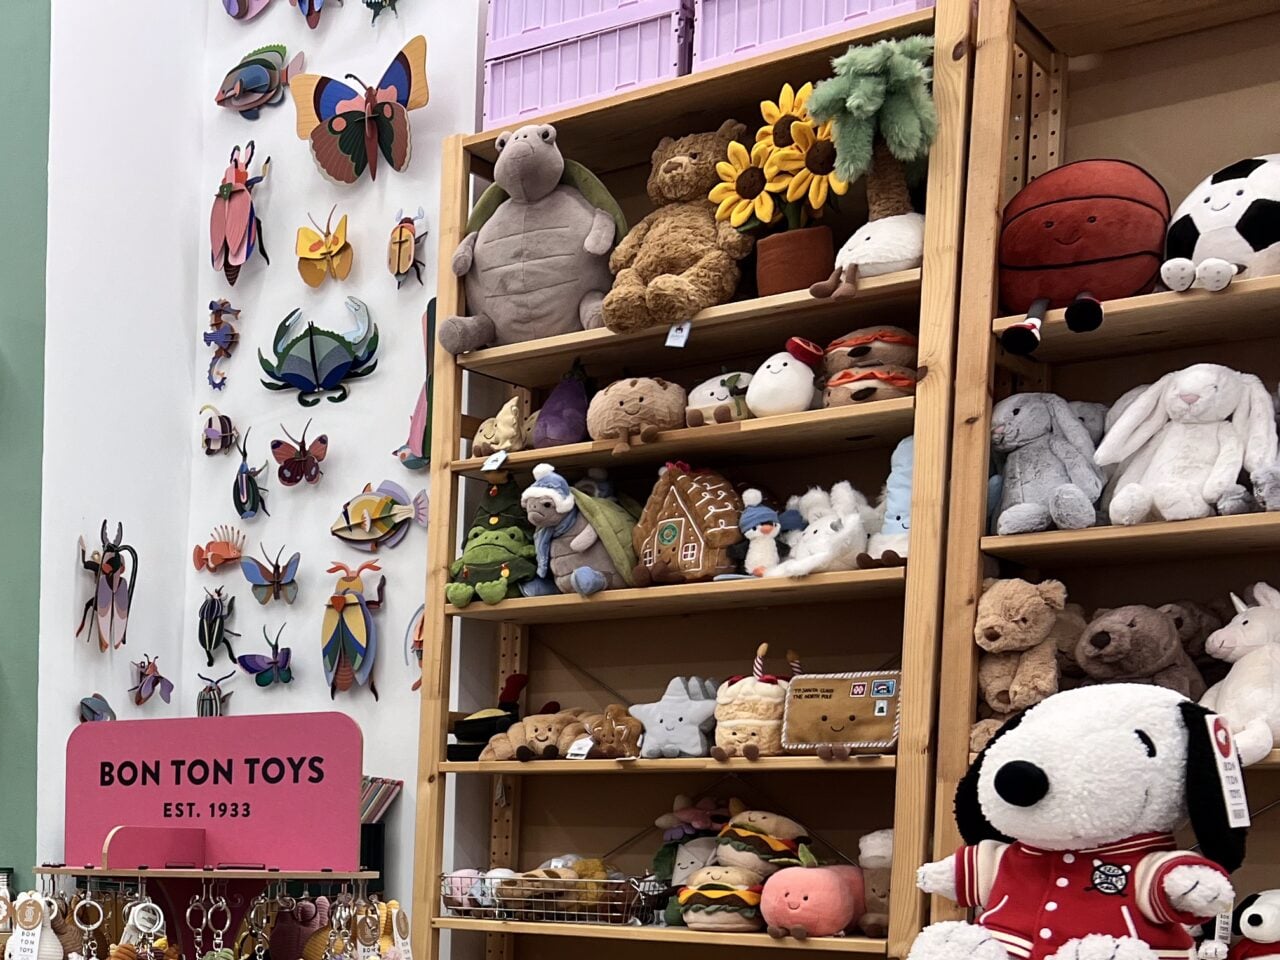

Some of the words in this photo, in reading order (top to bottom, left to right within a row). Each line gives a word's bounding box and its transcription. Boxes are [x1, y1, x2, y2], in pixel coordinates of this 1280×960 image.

[100, 760, 160, 786] BON
[170, 758, 233, 785] TON
[244, 756, 325, 784] TOYS
[163, 802, 200, 818] EST.
[209, 802, 250, 818] 1933
